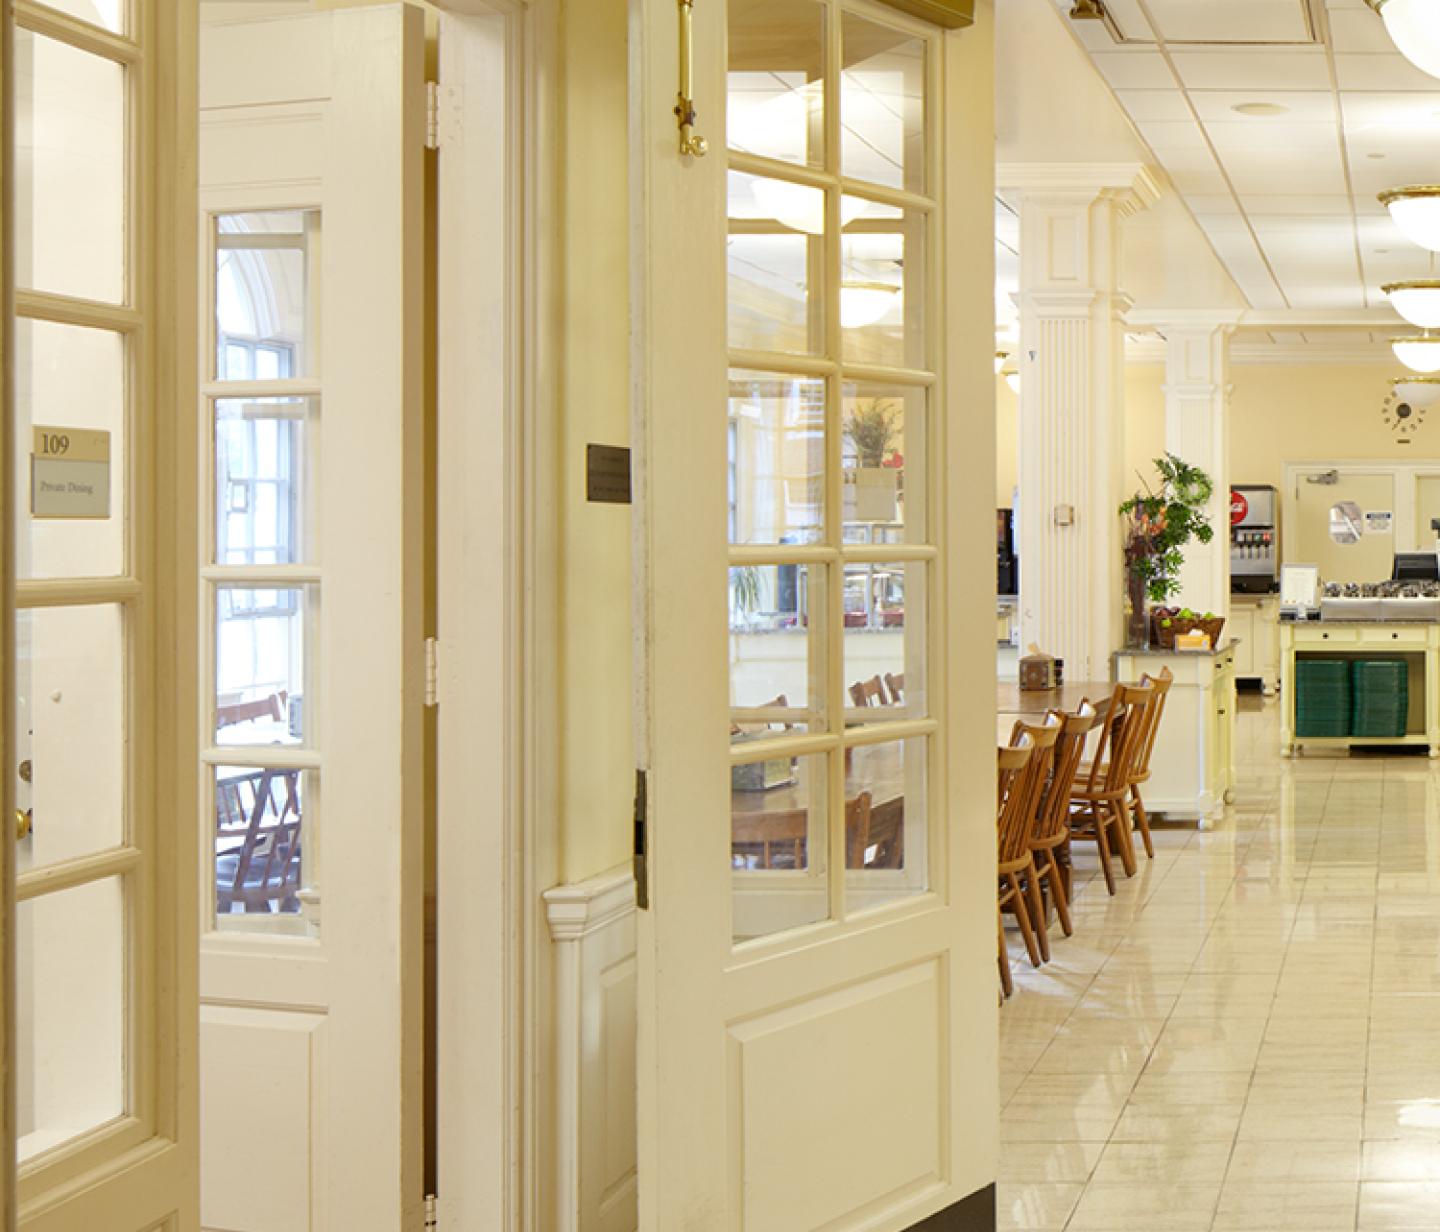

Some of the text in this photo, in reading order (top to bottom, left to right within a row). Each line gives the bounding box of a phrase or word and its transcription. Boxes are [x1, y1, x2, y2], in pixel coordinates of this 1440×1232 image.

[42, 433, 69, 454] 109
[41, 481, 93, 495] Private Dining
